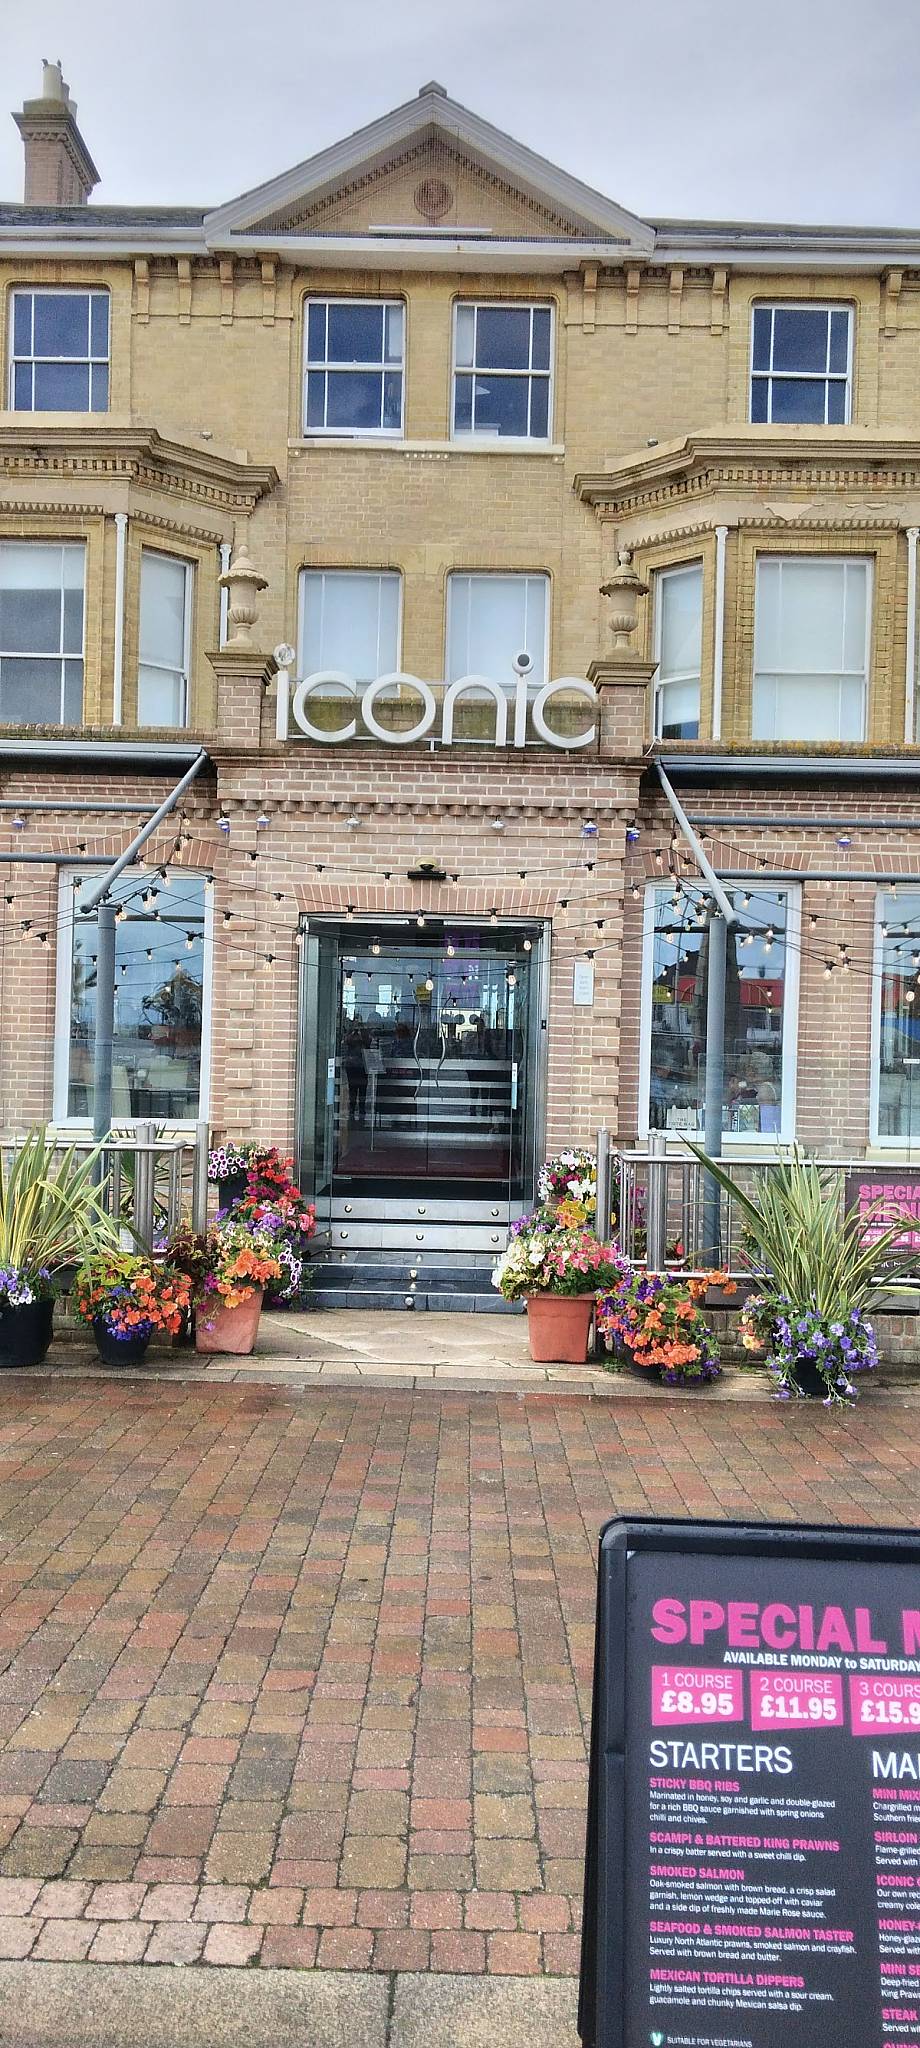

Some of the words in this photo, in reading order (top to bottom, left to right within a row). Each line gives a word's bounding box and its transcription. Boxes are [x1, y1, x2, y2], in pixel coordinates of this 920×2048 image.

[272, 642, 596, 749] iconic
[651, 1598, 888, 1655] SPECIAL
[723, 1652, 788, 1665] AVAILABLE
[790, 1655, 843, 1668] MONDAY
[844, 1658, 858, 1669] to
[662, 1672, 670, 1686] 1
[674, 1673, 733, 1689] COURSE
[760, 1677, 769, 1691] 2
[773, 1678, 832, 1693] COURSE
[860, 1682, 869, 1696] 3
[661, 1691, 734, 1714] £8.95
[760, 1696, 837, 1719] £11.95
[650, 1741, 793, 1772] STARTERS
[650, 1778, 687, 1788] STICKY
[689, 1780, 713, 1791] BBQ
[714, 1781, 740, 1792] RIBS
[650, 1791, 686, 1800] Marinated
[696, 1794, 719, 1803] honey,
[720, 1796, 733, 1804] soy
[749, 1797, 770, 1805] garlic
[786, 1799, 836, 1808] double-glazed
[872, 1788, 897, 1800] MINI
[649, 1802, 660, 1810] for
[668, 1803, 682, 1811] rich
[682, 1803, 699, 1813] BBQ
[723, 1807, 759, 1815] garnished
[759, 1808, 776, 1816] with
[776, 1810, 800, 1819] spring
[800, 1810, 825, 1818] onions
[872, 1802, 912, 1812] Chargrilled
[683, 1815, 708, 1824] chives.
[874, 1813, 906, 1822] Southern
[650, 1832, 692, 1843] SCAMPI
[694, 1834, 704, 1844] &
[706, 1835, 761, 1847] BATTERED
[763, 1838, 790, 1848] KING
[792, 1839, 840, 1851] PRAWNS
[874, 1831, 918, 1843] SIRLOIN
[664, 1847, 685, 1856] crispy
[685, 1848, 707, 1856] batter
[732, 1850, 747, 1858] with
[754, 1852, 775, 1860] sweet
[776, 1852, 792, 1860] chilli
[793, 1853, 806, 1862] dip.
[876, 1856, 901, 1865] Served
[902, 1858, 918, 1866] with
[650, 1866, 697, 1877] SMOKED
[699, 1868, 745, 1880] SALMON
[649, 1879, 695, 1889] Oak-smoked
[696, 1882, 723, 1890] salmon
[741, 1884, 763, 1892] brown
[764, 1886, 789, 1894] bread,
[796, 1888, 815, 1896] crisp
[815, 1888, 836, 1896] salad
[876, 1875, 914, 1887] ICONIC
[649, 1892, 679, 1900] garnish,
[680, 1892, 704, 1900] lemon
[704, 1894, 729, 1903] wedge
[729, 1895, 744, 1903] and
[745, 1896, 783, 1905] topped-off
[877, 1888, 890, 1897] Our
[892, 1890, 906, 1898] own
[650, 1902, 664, 1910] and
[688, 1904, 701, 1913] dip
[702, 1904, 710, 1912] of
[711, 1905, 736, 1915] freshly
[737, 1907, 758, 1915] made
[759, 1907, 781, 1916] Marie
[782, 1908, 801, 1917] Rose
[877, 1902, 904, 1911] creamy
[650, 1922, 701, 1933] SEAFOOD
[703, 1924, 713, 1934] &
[714, 1925, 762, 1937] SMOKED
[764, 1928, 811, 1939] SALMON
[813, 1930, 854, 1941] TASTER
[879, 1920, 920, 1932] HONEY-
[650, 1936, 674, 1946] Luxury
[674, 1936, 695, 1945] North
[696, 1938, 723, 1947] Atlantic
[753, 1942, 783, 1950] smoked
[783, 1943, 811, 1951] salmon
[826, 1945, 857, 1954] crayfish.
[879, 1945, 905, 1954] Served
[649, 1947, 676, 1956] Served
[693, 1949, 717, 1958] brown
[718, 1950, 740, 1959] bread
[756, 1953, 782, 1961] butter.
[880, 1964, 906, 1975] MINI
[650, 1970, 701, 1981] MEXICAN
[703, 1972, 754, 1984] TORTILLA
[756, 1975, 805, 1987] DIPPERS
[881, 1977, 919, 1987] Deep-fried
[650, 1984, 673, 1993] Lightly
[674, 1985, 697, 1994] salted
[697, 1986, 721, 1995] tortilla
[721, 1987, 742, 1996] chips
[742, 1989, 767, 1997] served
[768, 1990, 784, 1998] with
[881, 1990, 899, 2000] King
[649, 1996, 690, 2005] guacamole
[691, 1998, 706, 2006] and
[707, 1998, 735, 2008] chunky
[735, 1999, 767, 2008] Mexican
[768, 2002, 788, 2010] salsa
[789, 2003, 803, 2011] dip.
[882, 2009, 918, 2020] STEAK
[882, 2024, 909, 2032] Served
